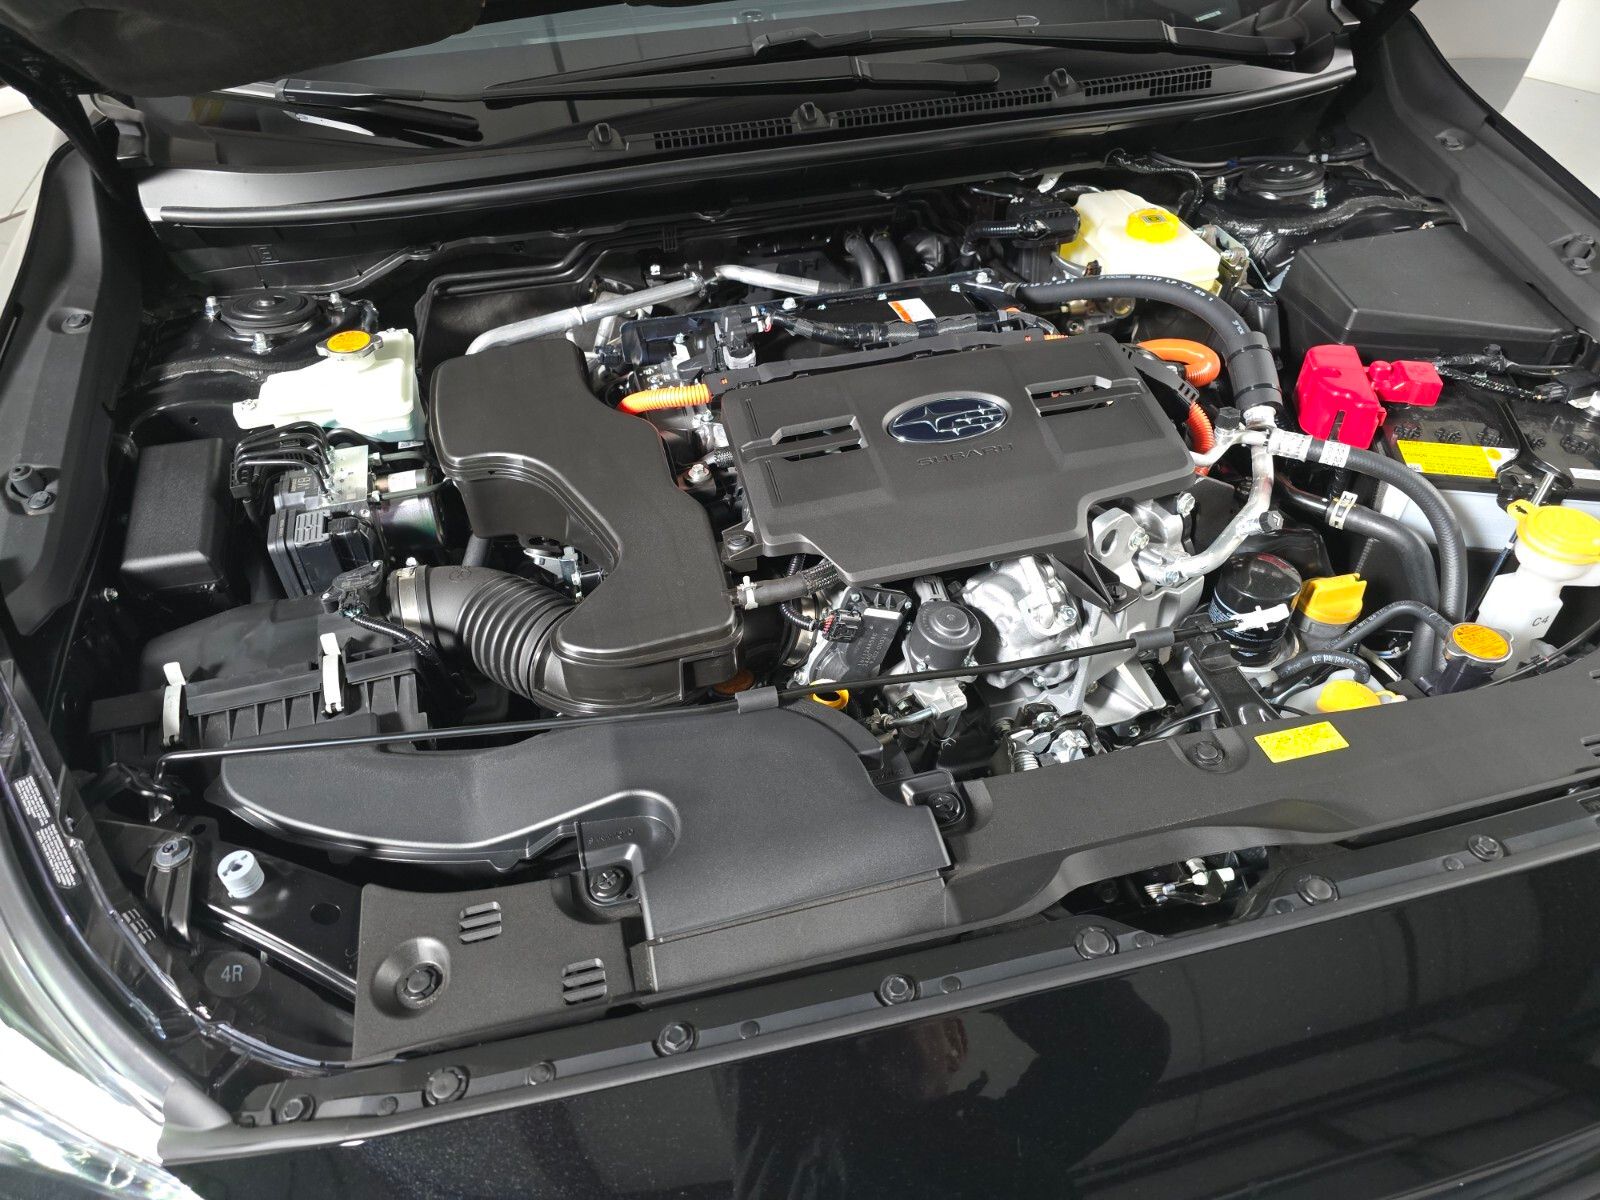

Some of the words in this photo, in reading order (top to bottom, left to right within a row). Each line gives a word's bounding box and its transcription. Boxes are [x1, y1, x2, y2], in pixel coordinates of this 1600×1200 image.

[917, 442, 1014, 466] SUBARU
[1531, 615, 1550, 627] C4
[221, 964, 243, 982] 4R
